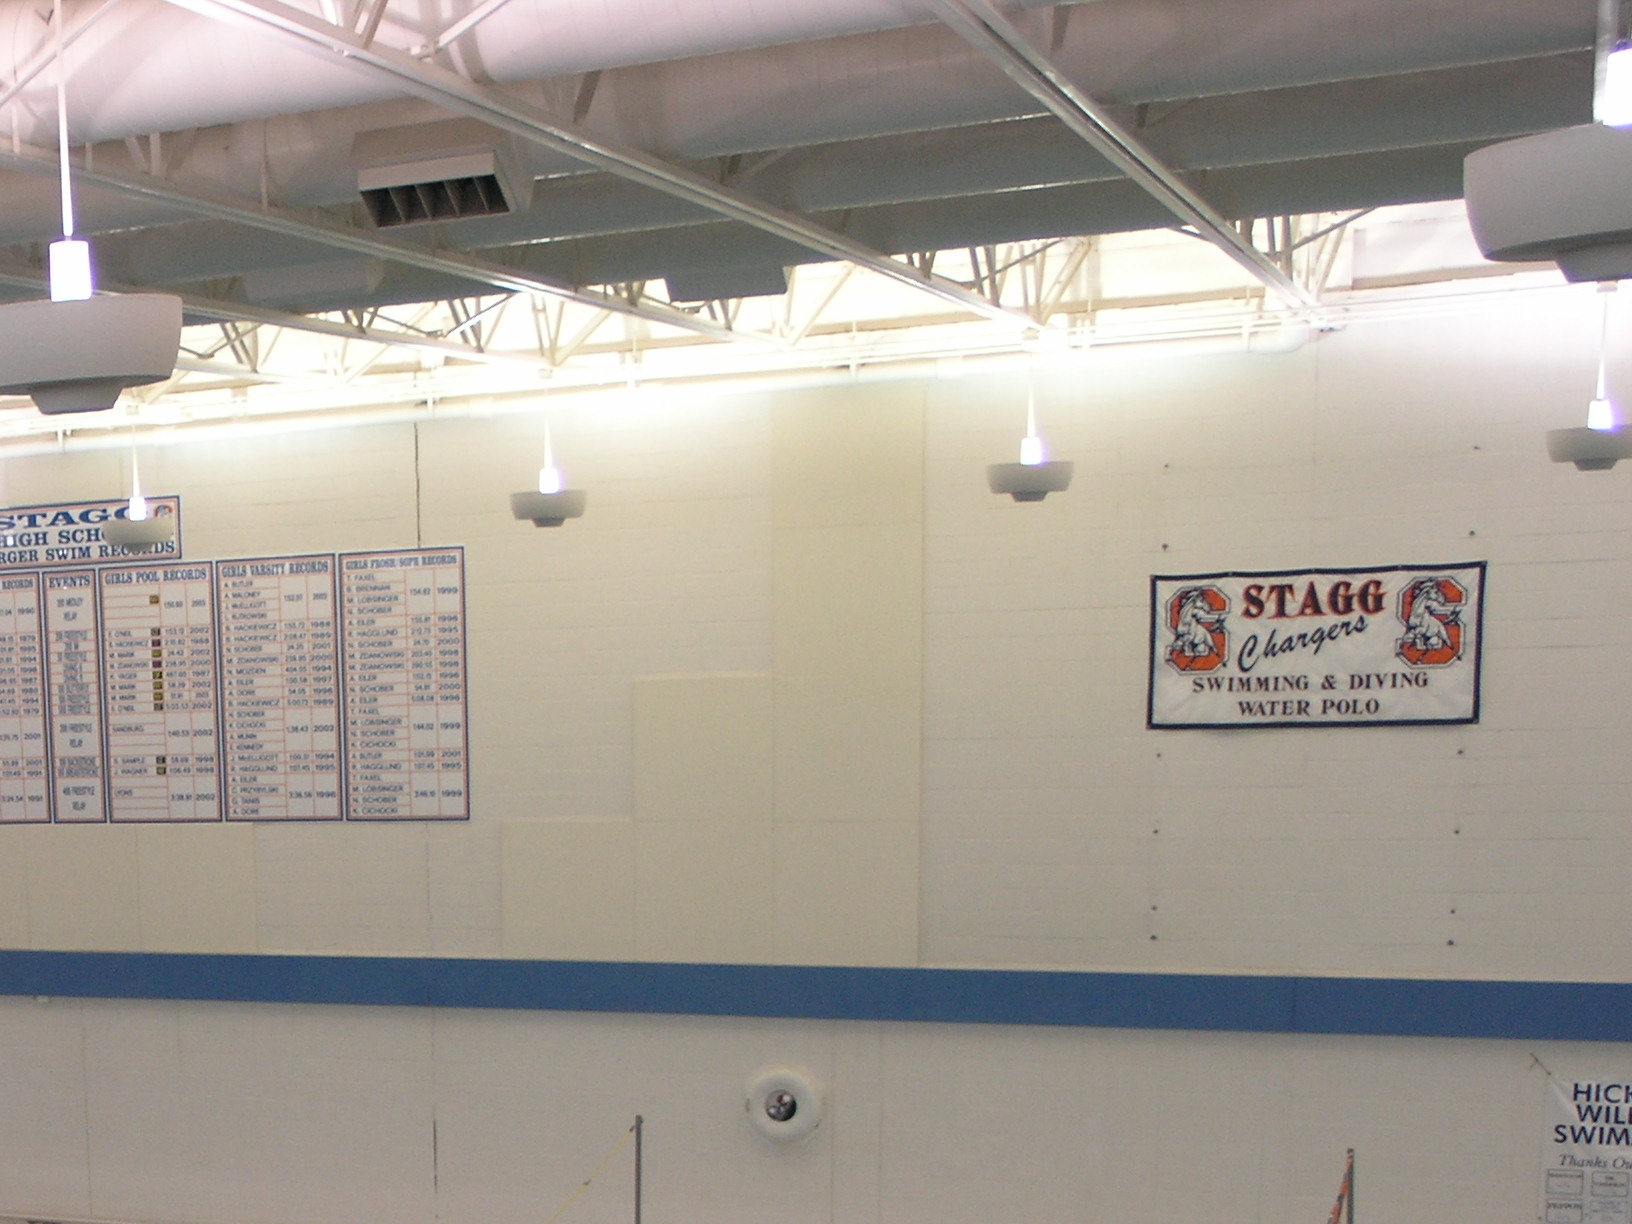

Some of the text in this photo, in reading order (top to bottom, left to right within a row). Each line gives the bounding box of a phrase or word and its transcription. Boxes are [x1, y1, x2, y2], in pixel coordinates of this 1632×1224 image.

[58, 528, 105, 543] SCH
[46, 546, 91, 561] SWIM
[98, 542, 175, 557] RECDS
[105, 568, 207, 584] GIRLS POOL RECORDS
[223, 561, 328, 577] GIRLS VARSITY RECORDS
[49, 575, 90, 587] EVENTS
[1240, 579, 1388, 619] STAGG
[1238, 615, 1368, 672] Chargers
[1193, 672, 1429, 692] SWIMMING & DIVING
[1238, 699, 1380, 717] WATER POLO
[1560, 1154, 1607, 1168] Thanks
